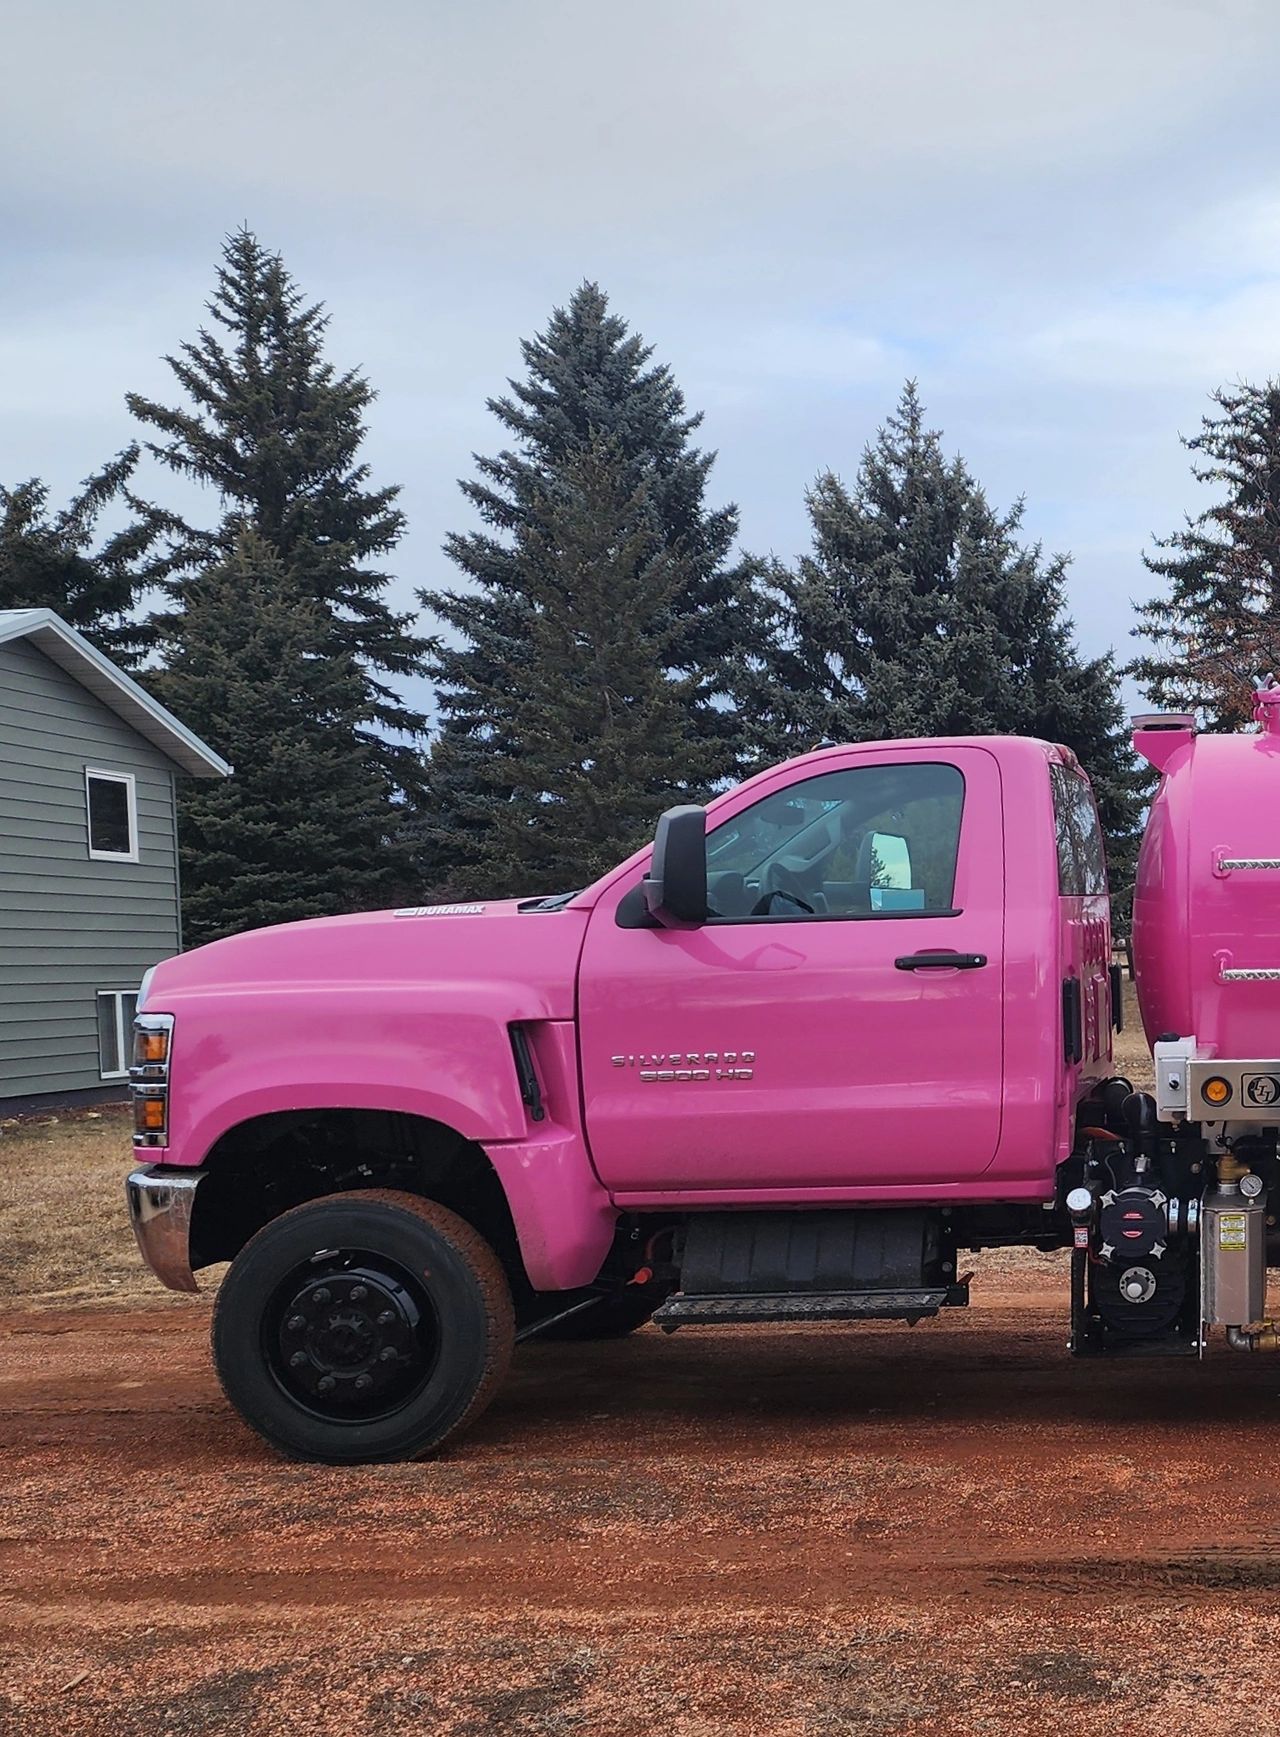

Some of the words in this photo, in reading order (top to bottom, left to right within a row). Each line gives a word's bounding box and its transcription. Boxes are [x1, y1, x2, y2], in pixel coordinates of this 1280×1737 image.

[417, 905, 486, 916] DURAMAX
[611, 1051, 755, 1067] SILVERADO
[715, 1068, 753, 1080] HD
